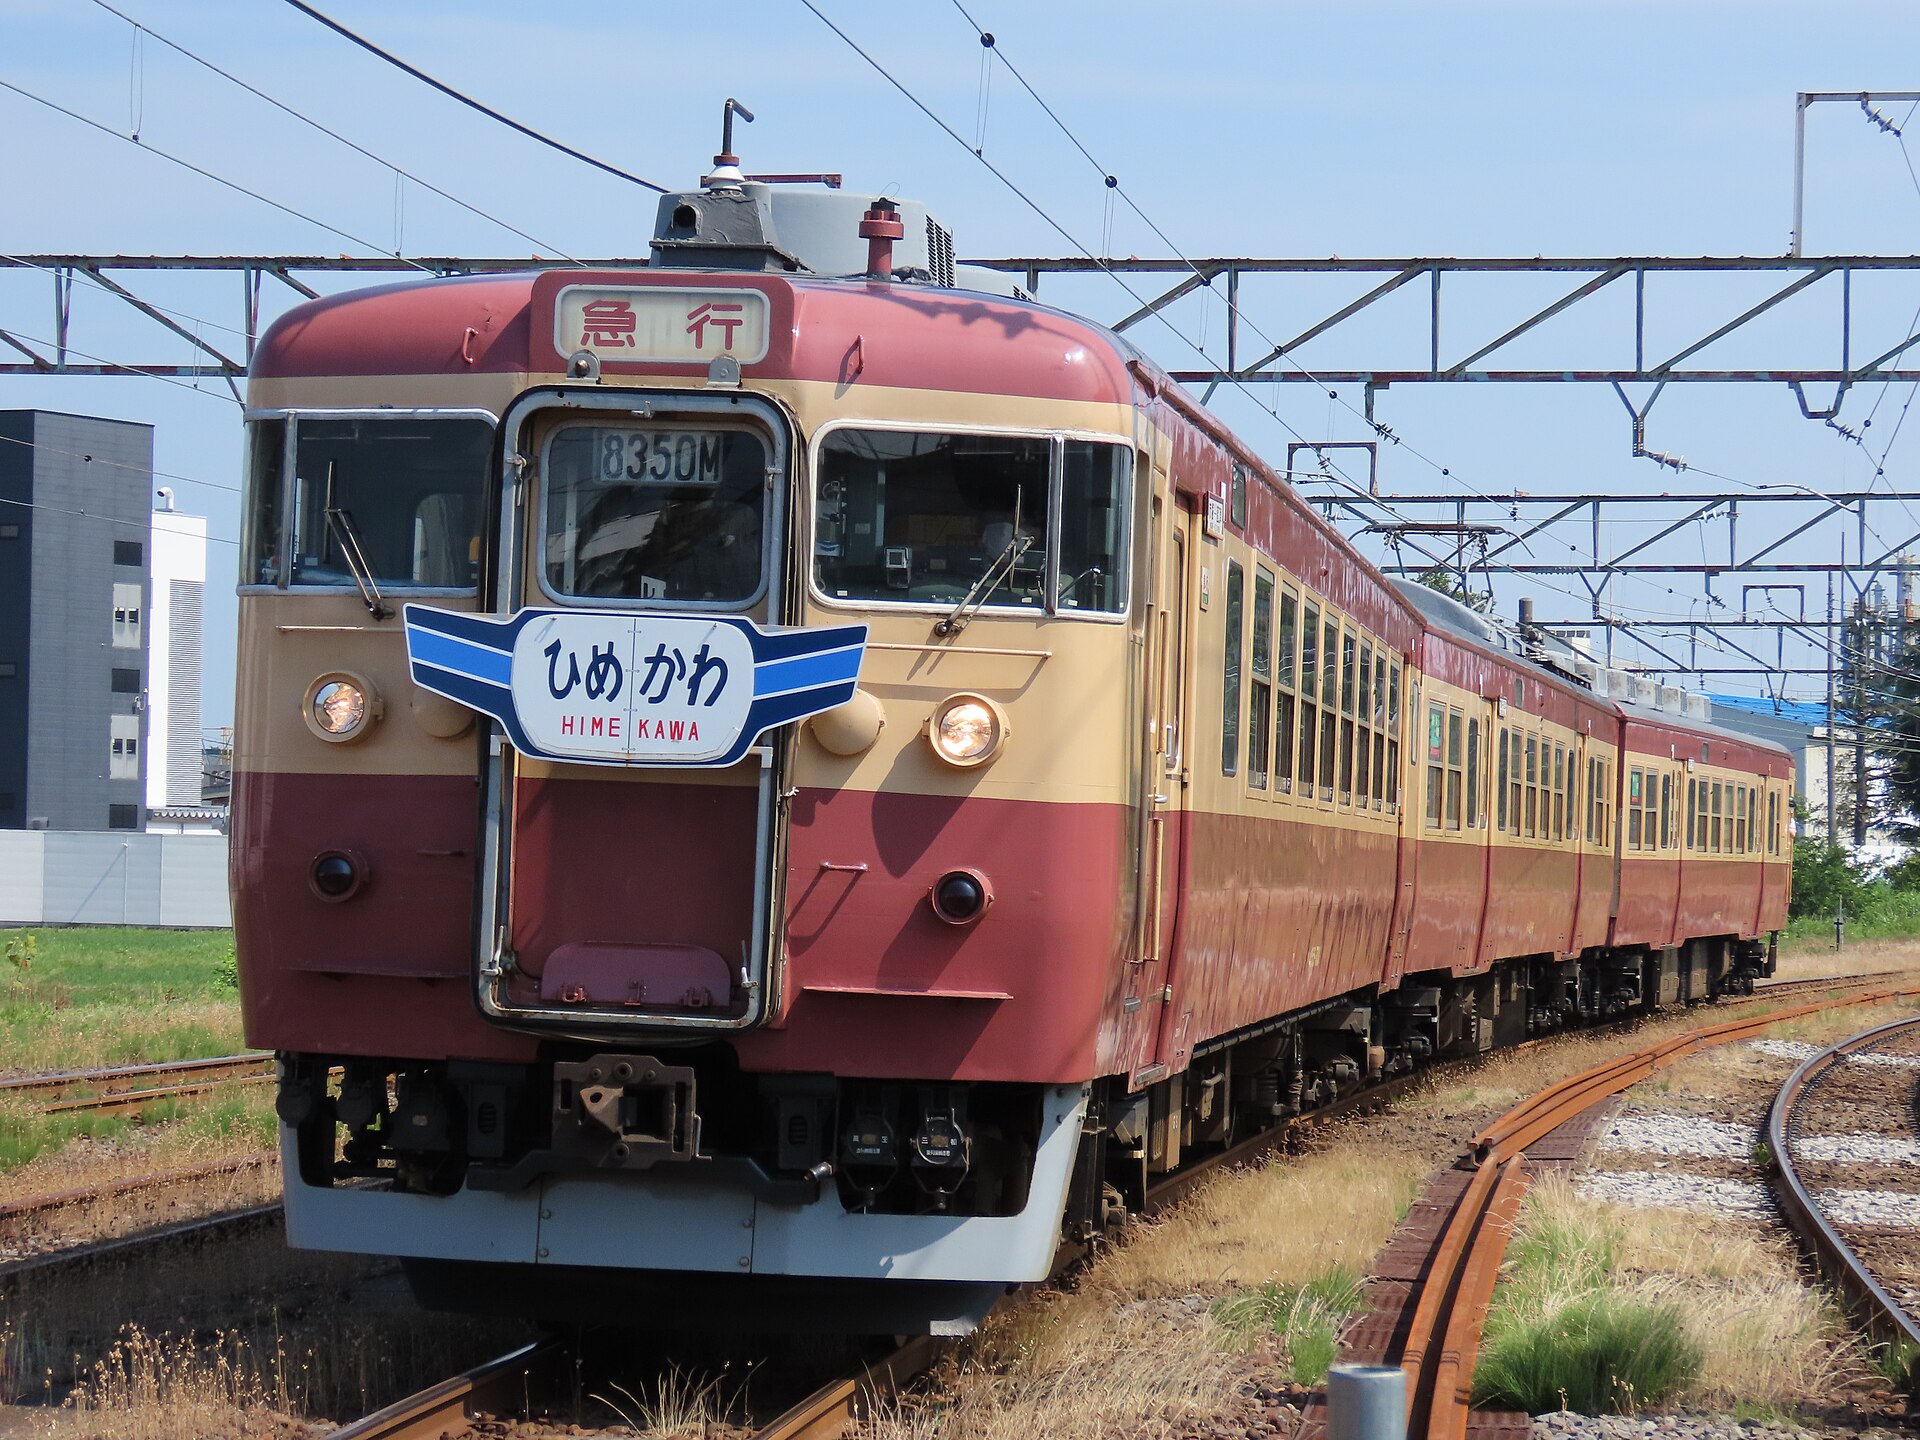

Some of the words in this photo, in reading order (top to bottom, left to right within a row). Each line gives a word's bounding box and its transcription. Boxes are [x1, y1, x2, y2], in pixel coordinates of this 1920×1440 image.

[581, 300, 743, 350] 急行
[602, 433, 721, 482] 8350M
[544, 638, 729, 707] ひめかわ
[561, 715, 621, 738] HIME
[638, 719, 700, 742] KAWA
